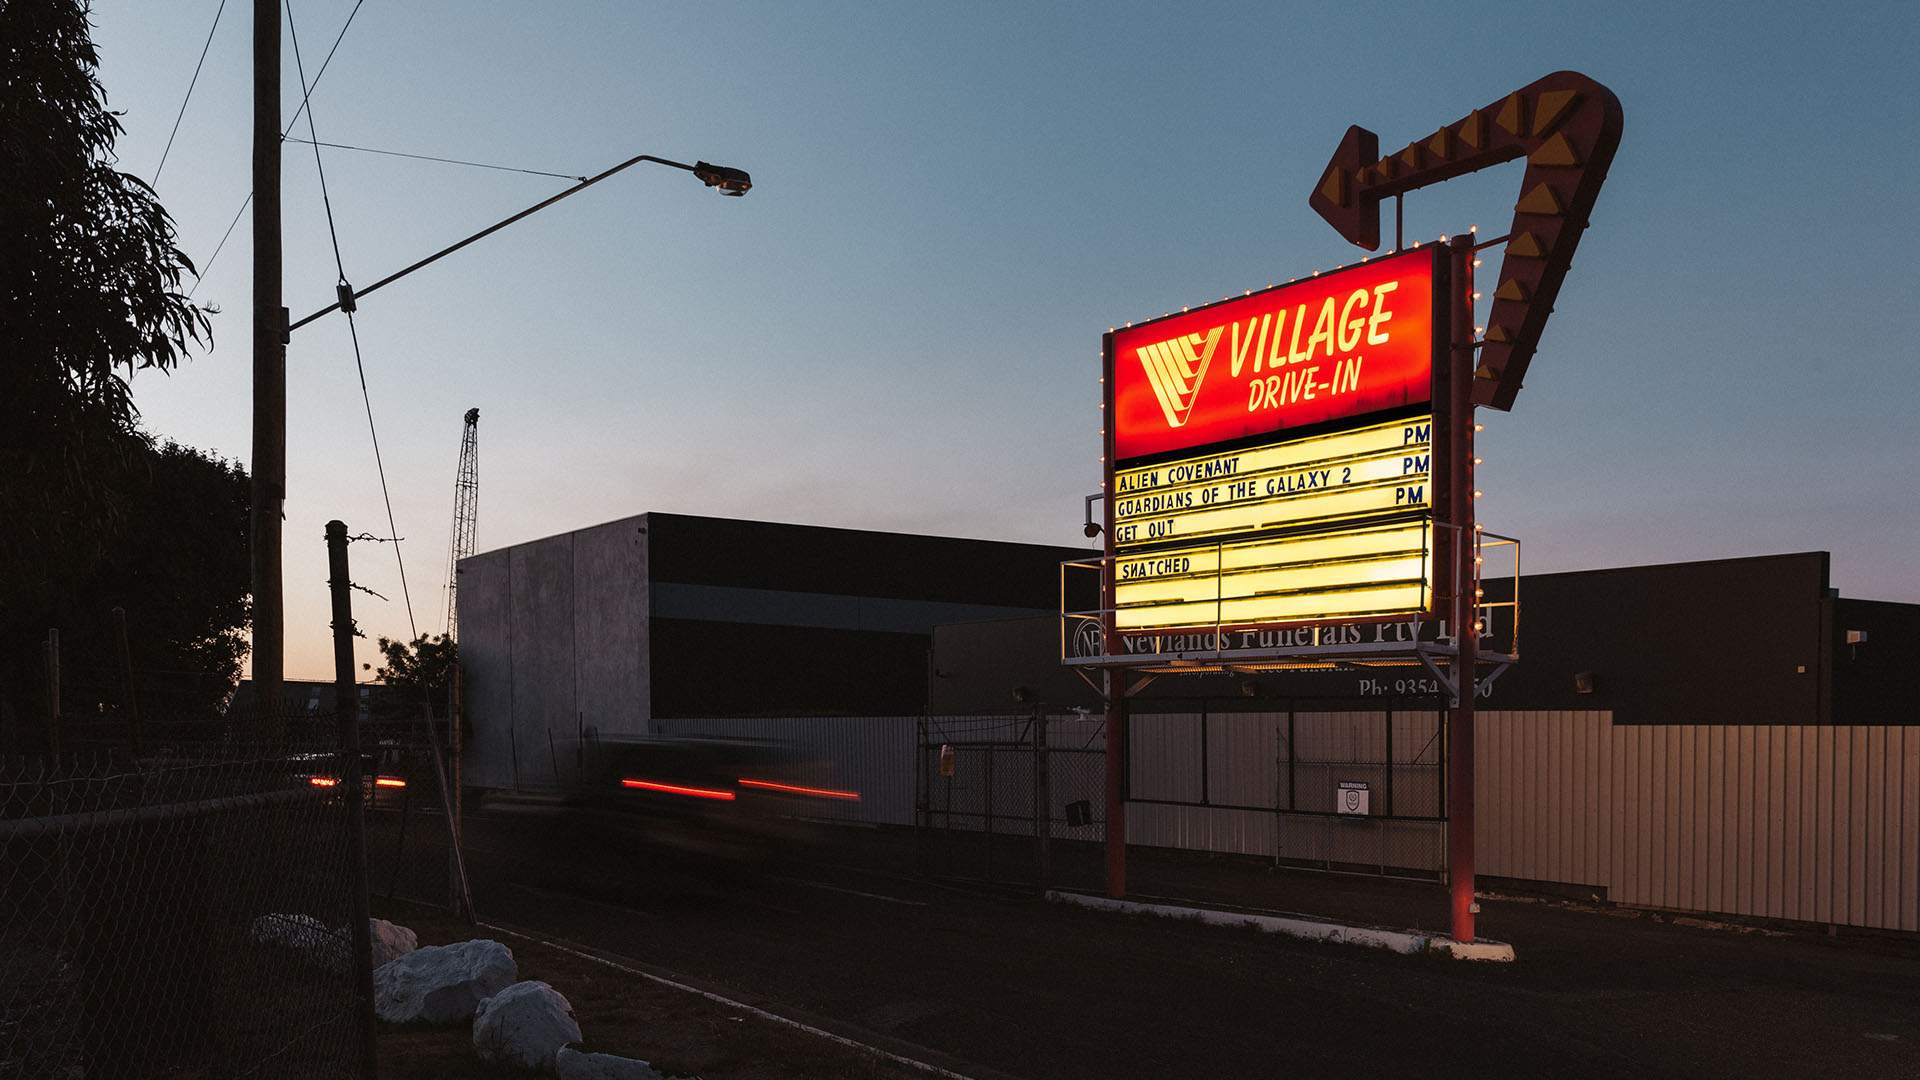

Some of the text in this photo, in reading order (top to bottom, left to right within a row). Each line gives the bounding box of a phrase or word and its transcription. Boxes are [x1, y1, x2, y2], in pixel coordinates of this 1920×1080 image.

[1230, 281, 1398, 377] VILLAGE
[1248, 356, 1363, 412] DRIVE-IN
[1119, 455, 1429, 516] GUARDIANS OF THE GALAXY 2 PM
[1120, 424, 1430, 491] ALIEN COVENANT PM
[1117, 486, 1423, 542] GET OUT PM
[1123, 558, 1189, 579] SNATCHED
[1436, 606, 1494, 639] Ld
